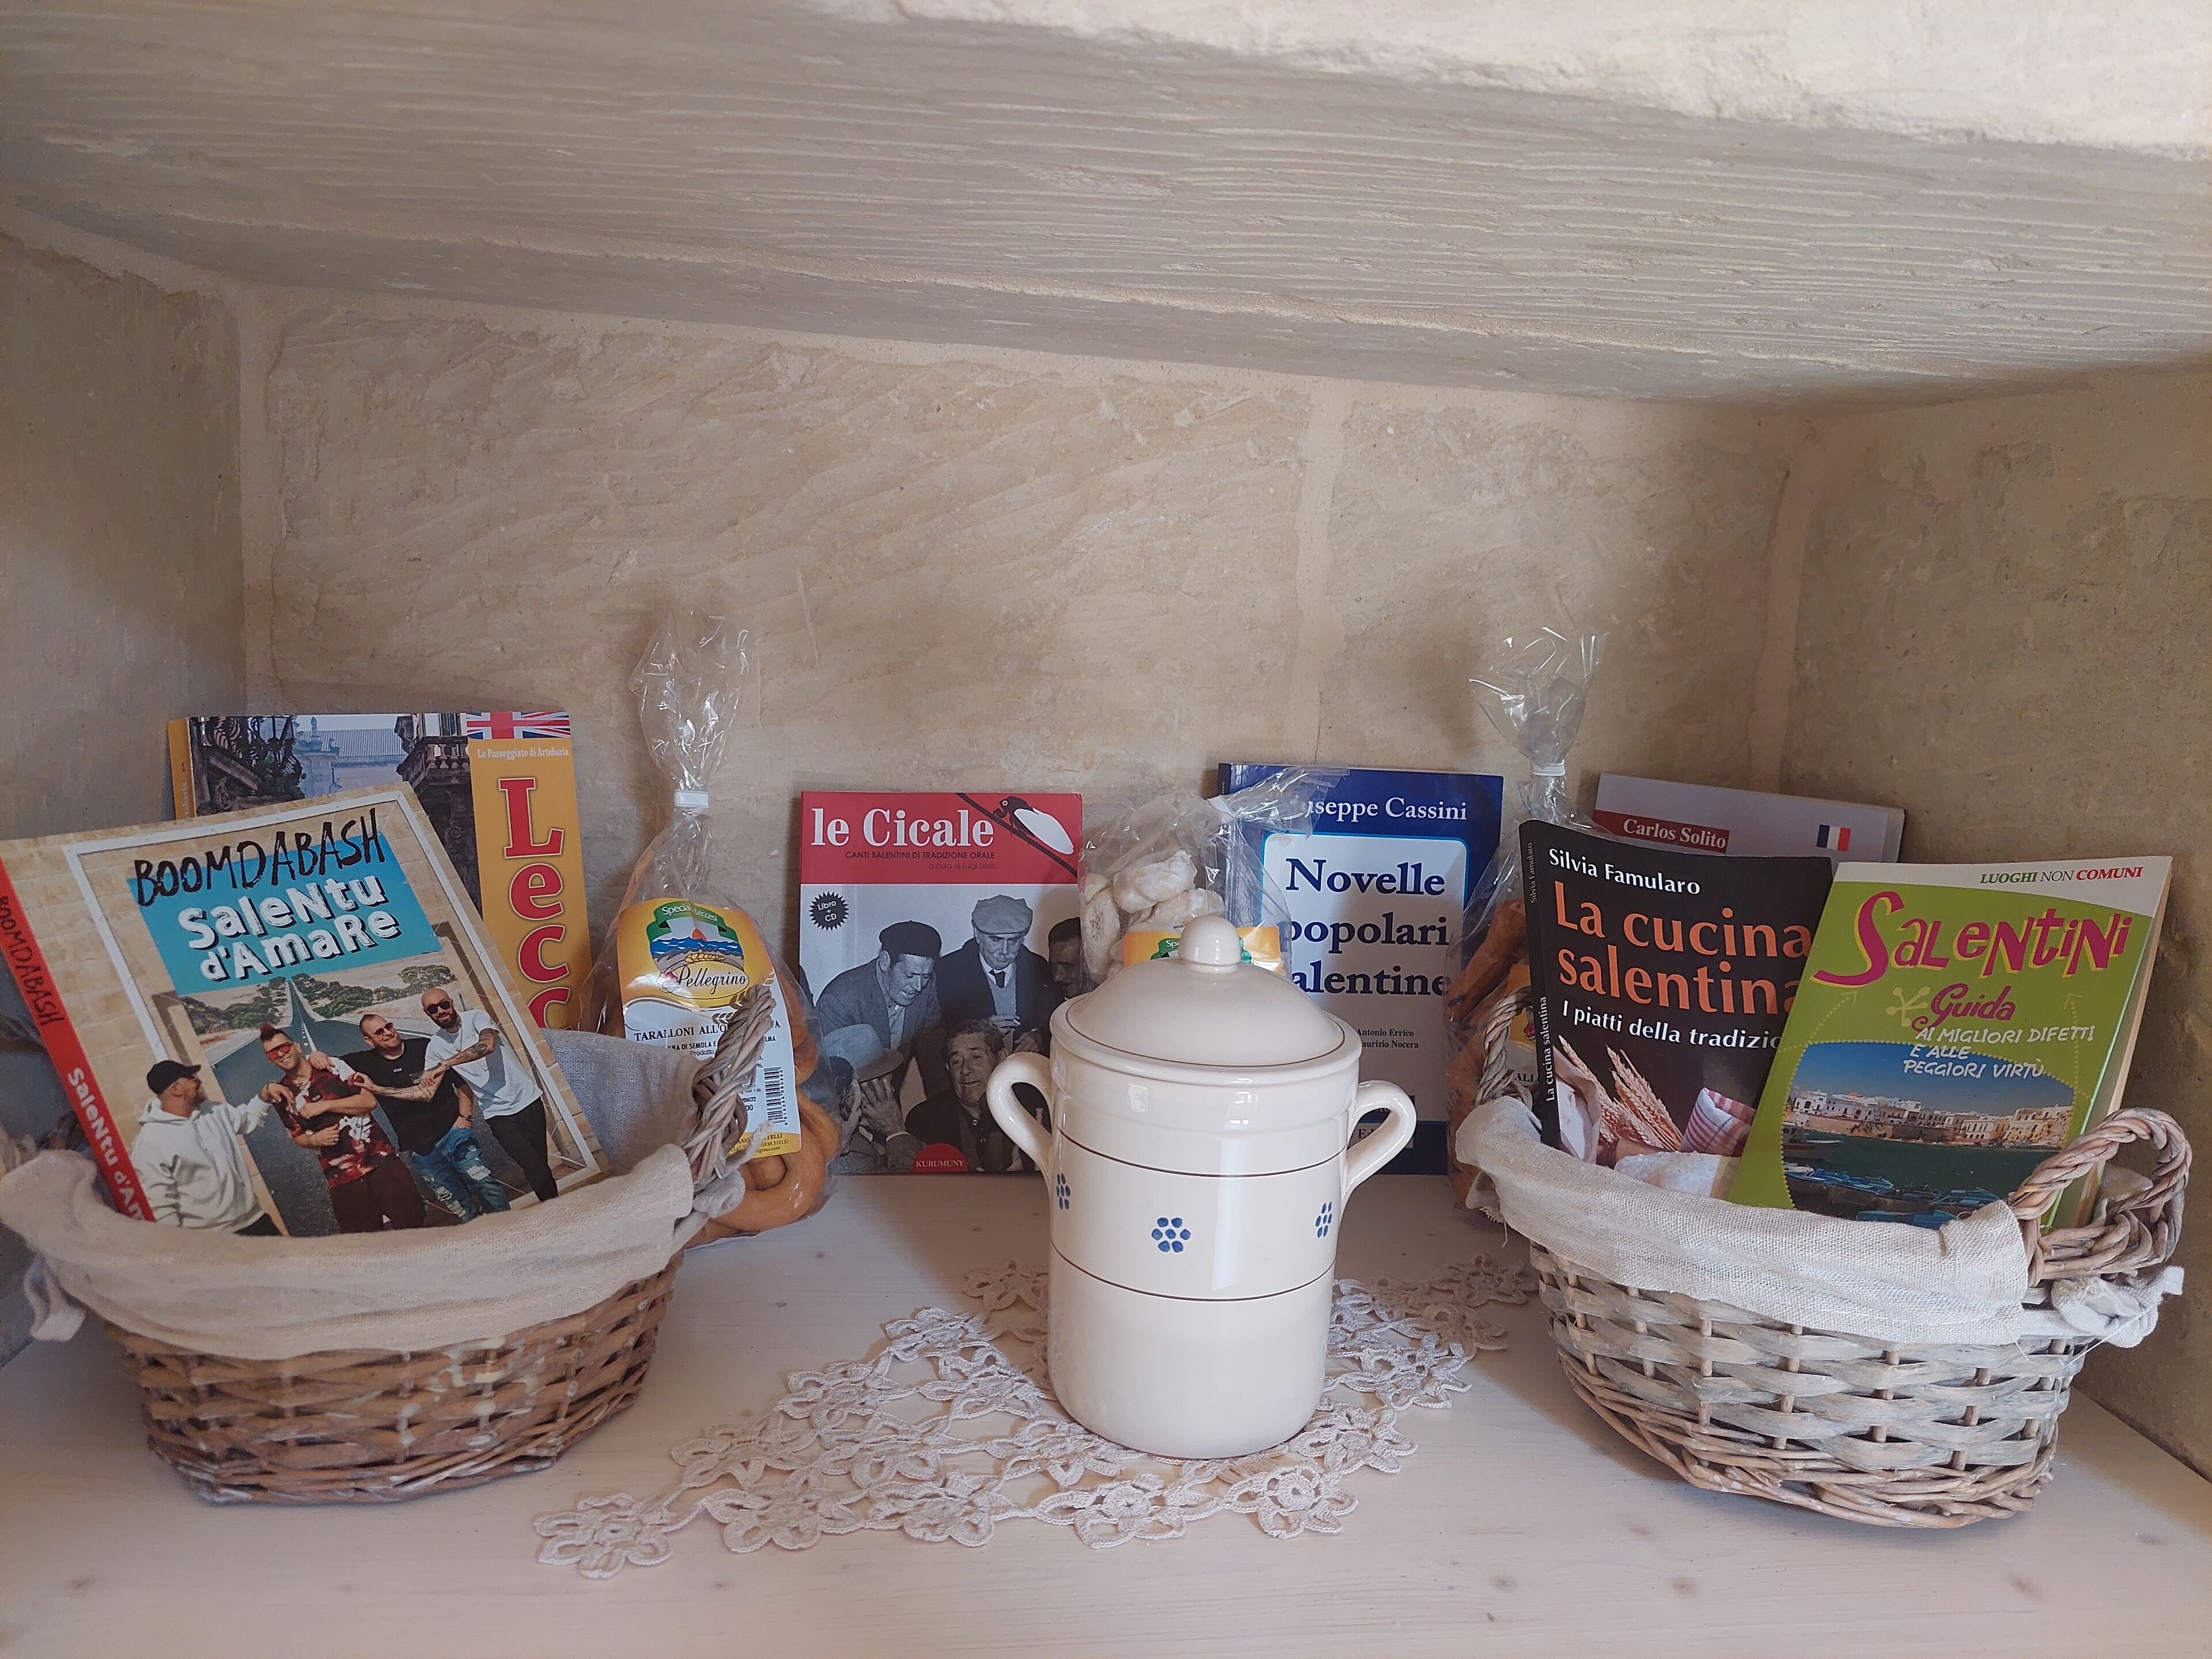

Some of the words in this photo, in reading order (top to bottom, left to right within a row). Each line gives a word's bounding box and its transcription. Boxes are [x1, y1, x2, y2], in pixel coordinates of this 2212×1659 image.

[478, 749, 486, 758] Le
[488, 748, 528, 760] Passeggiate
[529, 747, 536, 756] di
[537, 747, 569, 756] Artebaria
[1309, 800, 1378, 823] seppe
[1385, 797, 1467, 820] Cassini
[811, 808, 850, 846] le
[863, 808, 994, 847] Cicale
[1623, 818, 1676, 841] Carlos
[1679, 827, 1726, 849] Solito
[134, 808, 385, 906] BOOMDABASH
[1527, 842, 1536, 880] Famularo
[1549, 848, 1599, 877] Silvia
[1604, 862, 1700, 895] Famularo
[1285, 858, 1446, 896] Novelle
[1980, 872, 2038, 884] LUOGHI
[2039, 870, 2074, 882] NON
[2076, 867, 2143, 880] COMUNI
[498, 777, 573, 1029] Lecc
[1529, 881, 1537, 903] Silvia
[825, 913, 837, 922] CD
[1555, 880, 1605, 938] La
[1623, 907, 1812, 957] cucina
[679, 964, 747, 995] Pellegrino
[1291, 960, 1452, 997] alentine
[1540, 996, 1552, 1046] salentina
[1911, 983, 2016, 1032] Guida
[634, 1027, 694, 1041] TARALLONI
[699, 1024, 728, 1035] ALL'O
[1357, 1028, 1387, 1036] Antonio
[1389, 1029, 1414, 1037] Errico
[1562, 1000, 1569, 1016] I
[1574, 1006, 1622, 1032] piatti
[1628, 1017, 1680, 1043] della
[1688, 1029, 1782, 1049] tradizio
[1915, 1027, 1933, 1040] AI
[1937, 1028, 2021, 1044] MIGLIORI
[2027, 1025, 2096, 1043] DIFETTI
[690, 1041, 712, 1050] SEMOLA
[1362, 1040, 1389, 1048] aurizio
[1391, 1040, 1419, 1048] Nocera
[1910, 1044, 1922, 1058] E
[1926, 1046, 1972, 1059] ALLE
[1544, 1048, 1554, 1084] cucina
[1903, 1060, 1987, 1079] PEGGIORI
[1546, 1088, 1555, 1102] La
